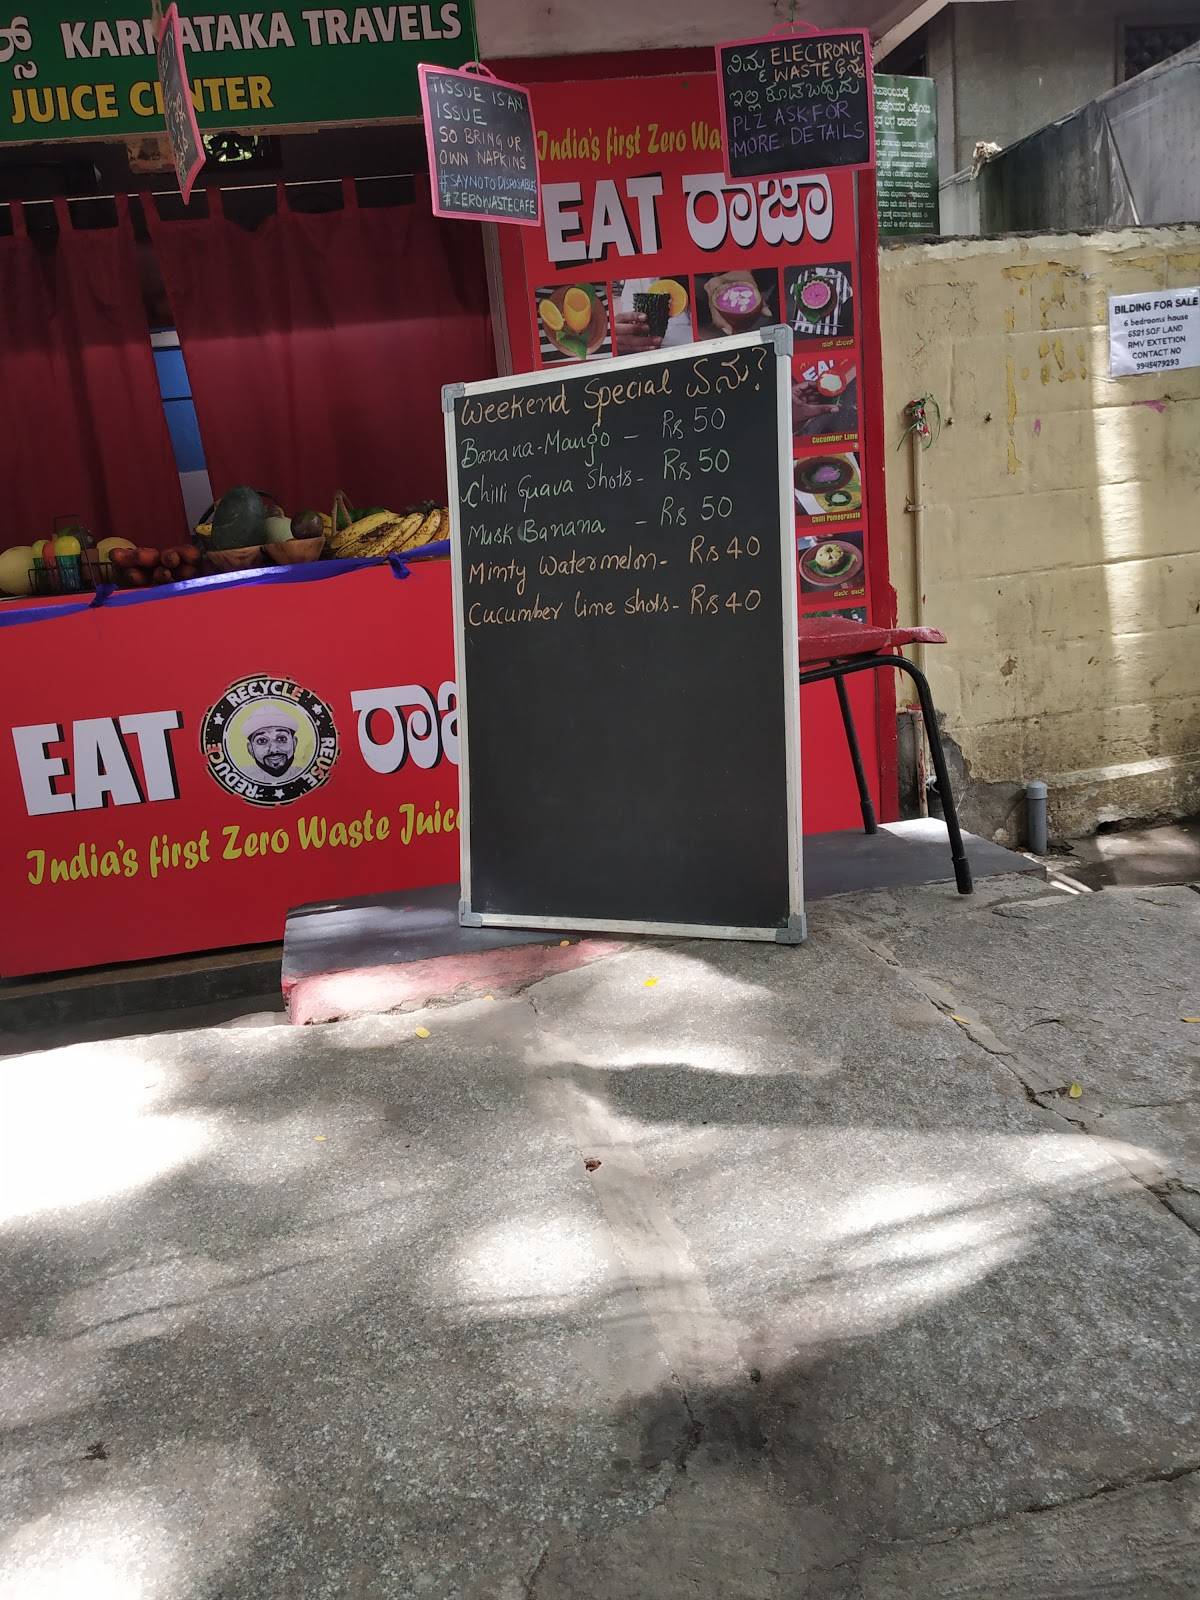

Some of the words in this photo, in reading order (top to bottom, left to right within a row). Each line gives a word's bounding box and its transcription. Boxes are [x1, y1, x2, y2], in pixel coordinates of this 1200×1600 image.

[302, 3, 462, 46] TRAVELS
[771, 40, 863, 65] ELECTRONIC
[774, 61, 830, 82] WASTE
[11, 83, 119, 124] JUICE
[429, 77, 486, 103] TISSUE
[436, 101, 487, 126] ISSUE
[733, 113, 767, 138] PLZ
[439, 127, 458, 144] SO
[464, 128, 503, 149] BRING
[507, 136, 522, 152] UR
[537, 128, 600, 162] India's
[606, 127, 641, 164] first
[647, 123, 686, 155] Zero
[733, 132, 781, 158] MORE
[790, 121, 865, 145] DETAILS
[439, 150, 469, 166] OWN
[477, 150, 527, 171] NAPKINS
[541, 175, 664, 263] EAT
[1114, 301, 1151, 315] BILDING
[1153, 300, 1173, 310] FOR
[1175, 297, 1198, 308] SALE
[1123, 319, 1129, 327] 6
[1130, 316, 1165, 326] bedrooms
[1167, 314, 1189, 322] house
[1127, 340, 1145, 349] RMV
[1147, 335, 1186, 347] EXTETION
[1162, 324, 1183, 334] LAND
[1132, 348, 1168, 360] CONTACT
[1170, 346, 1182, 355] NO
[584, 368, 673, 427] Special
[661, 409, 684, 440] Rs
[693, 406, 727, 433] 50
[662, 448, 692, 481] Rs
[698, 448, 731, 474] 50
[467, 525, 514, 547] Musk
[521, 518, 607, 544] Banana
[660, 496, 688, 527] Rs
[700, 495, 734, 522] 50
[469, 561, 527, 596] Minty
[689, 535, 720, 565] Rs
[726, 535, 762, 560] 40
[468, 591, 564, 626] Cucumber
[690, 583, 719, 616] Rs
[725, 588, 762, 614] 40
[225, 680, 304, 707] RECYCLE
[11, 710, 180, 816] EAT
[206, 742, 259, 799] REDUCE
[302, 737, 336, 787] REUSE
[26, 838, 139, 886] India's
[150, 830, 210, 879] first
[222, 825, 290, 861] Zero
[298, 809, 390, 850] Waste
[399, 799, 461, 846] Juic
